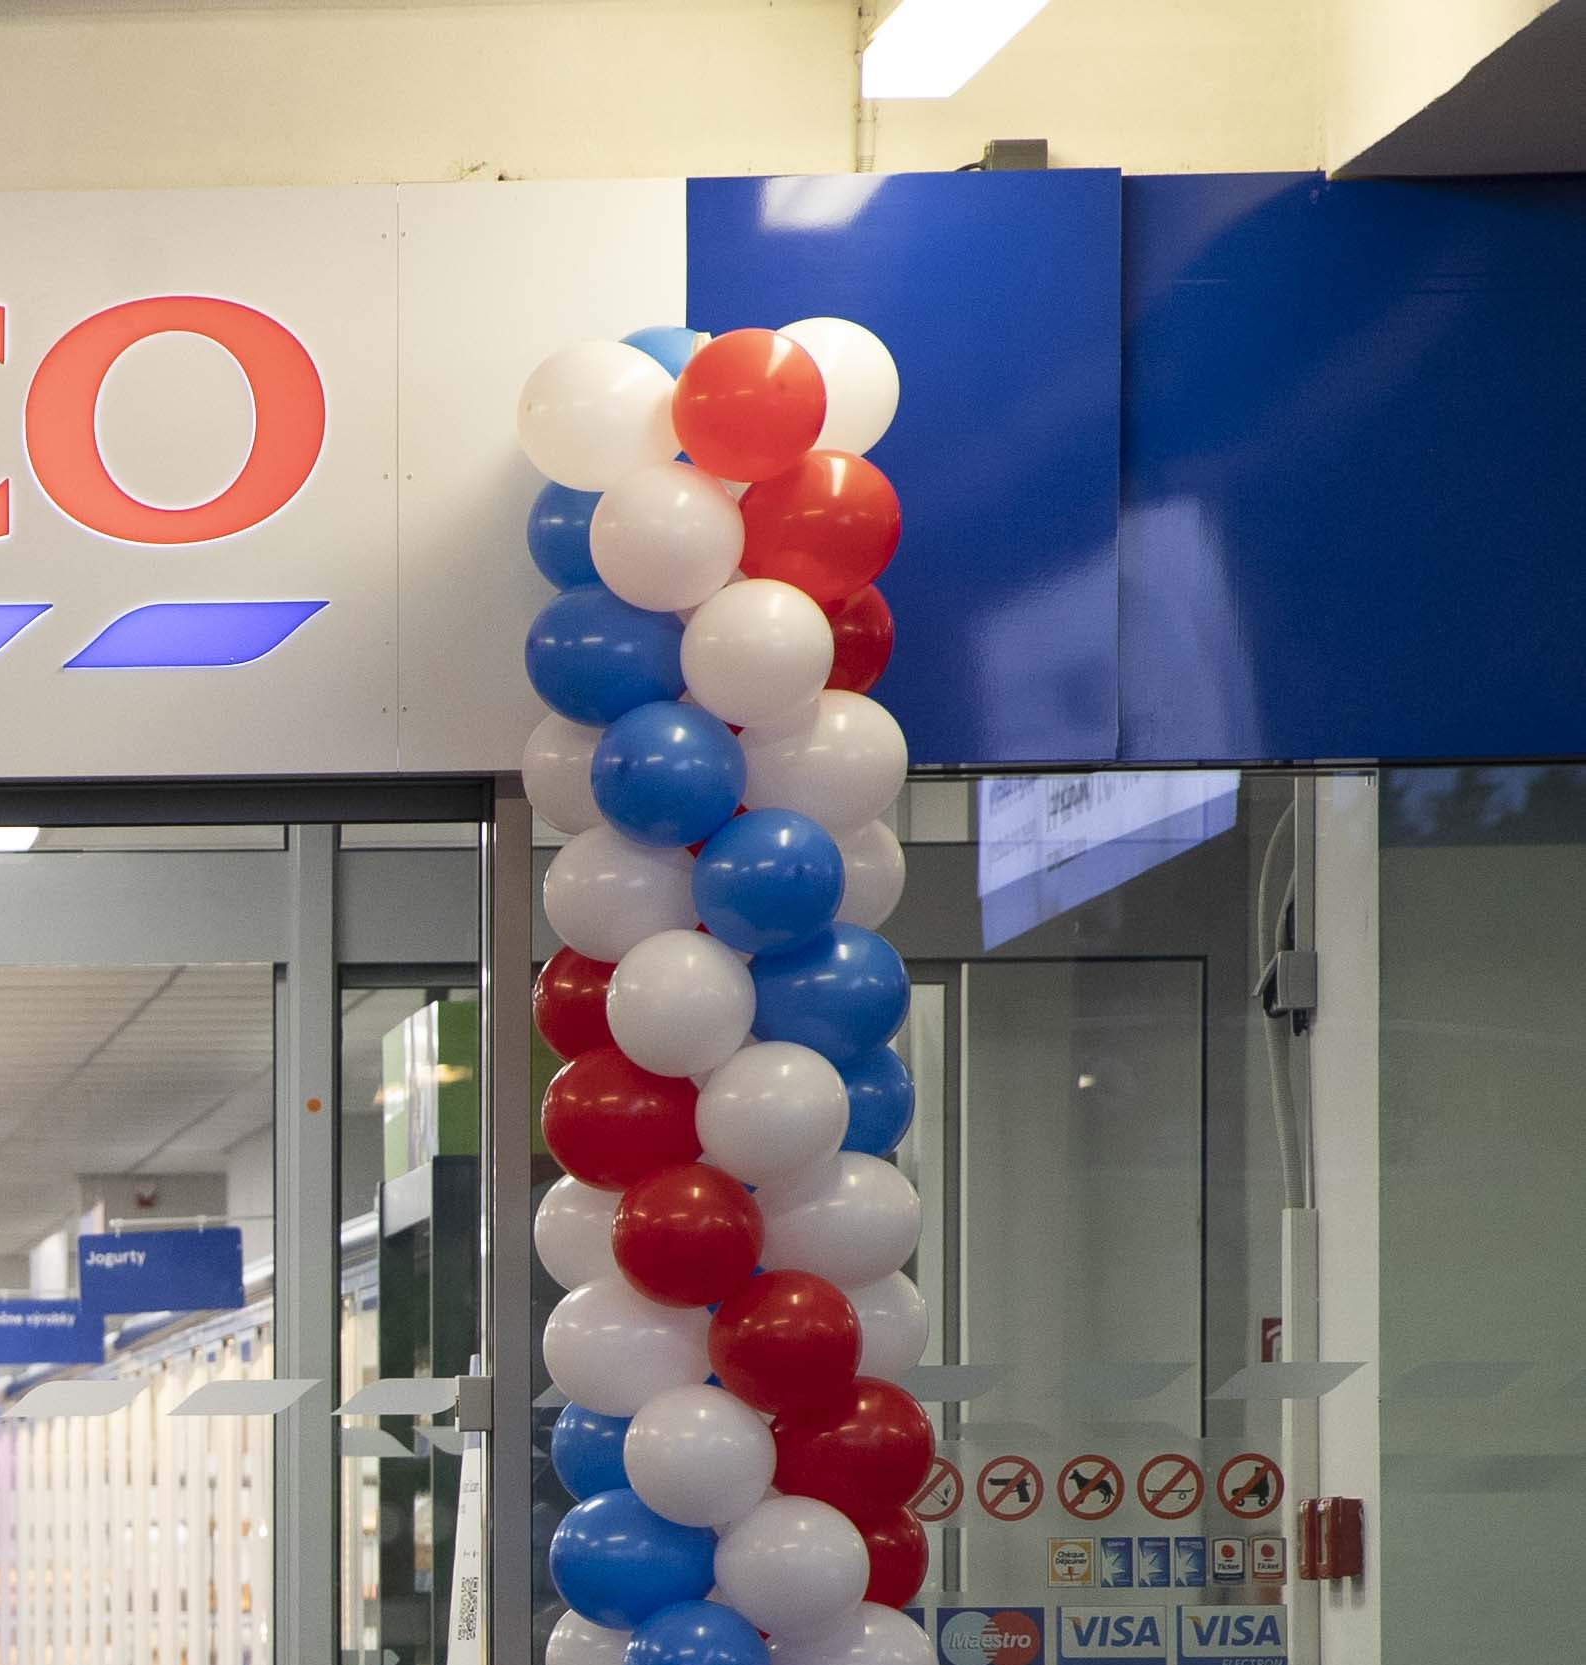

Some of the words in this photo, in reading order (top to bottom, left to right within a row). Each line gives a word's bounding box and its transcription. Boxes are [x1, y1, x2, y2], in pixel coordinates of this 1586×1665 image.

[86, 1249, 146, 1267] Jogurty
[948, 1630, 1032, 1650] Maestro
[1065, 1615, 1161, 1647] VISA
[1189, 1614, 1282, 1646] VISA
